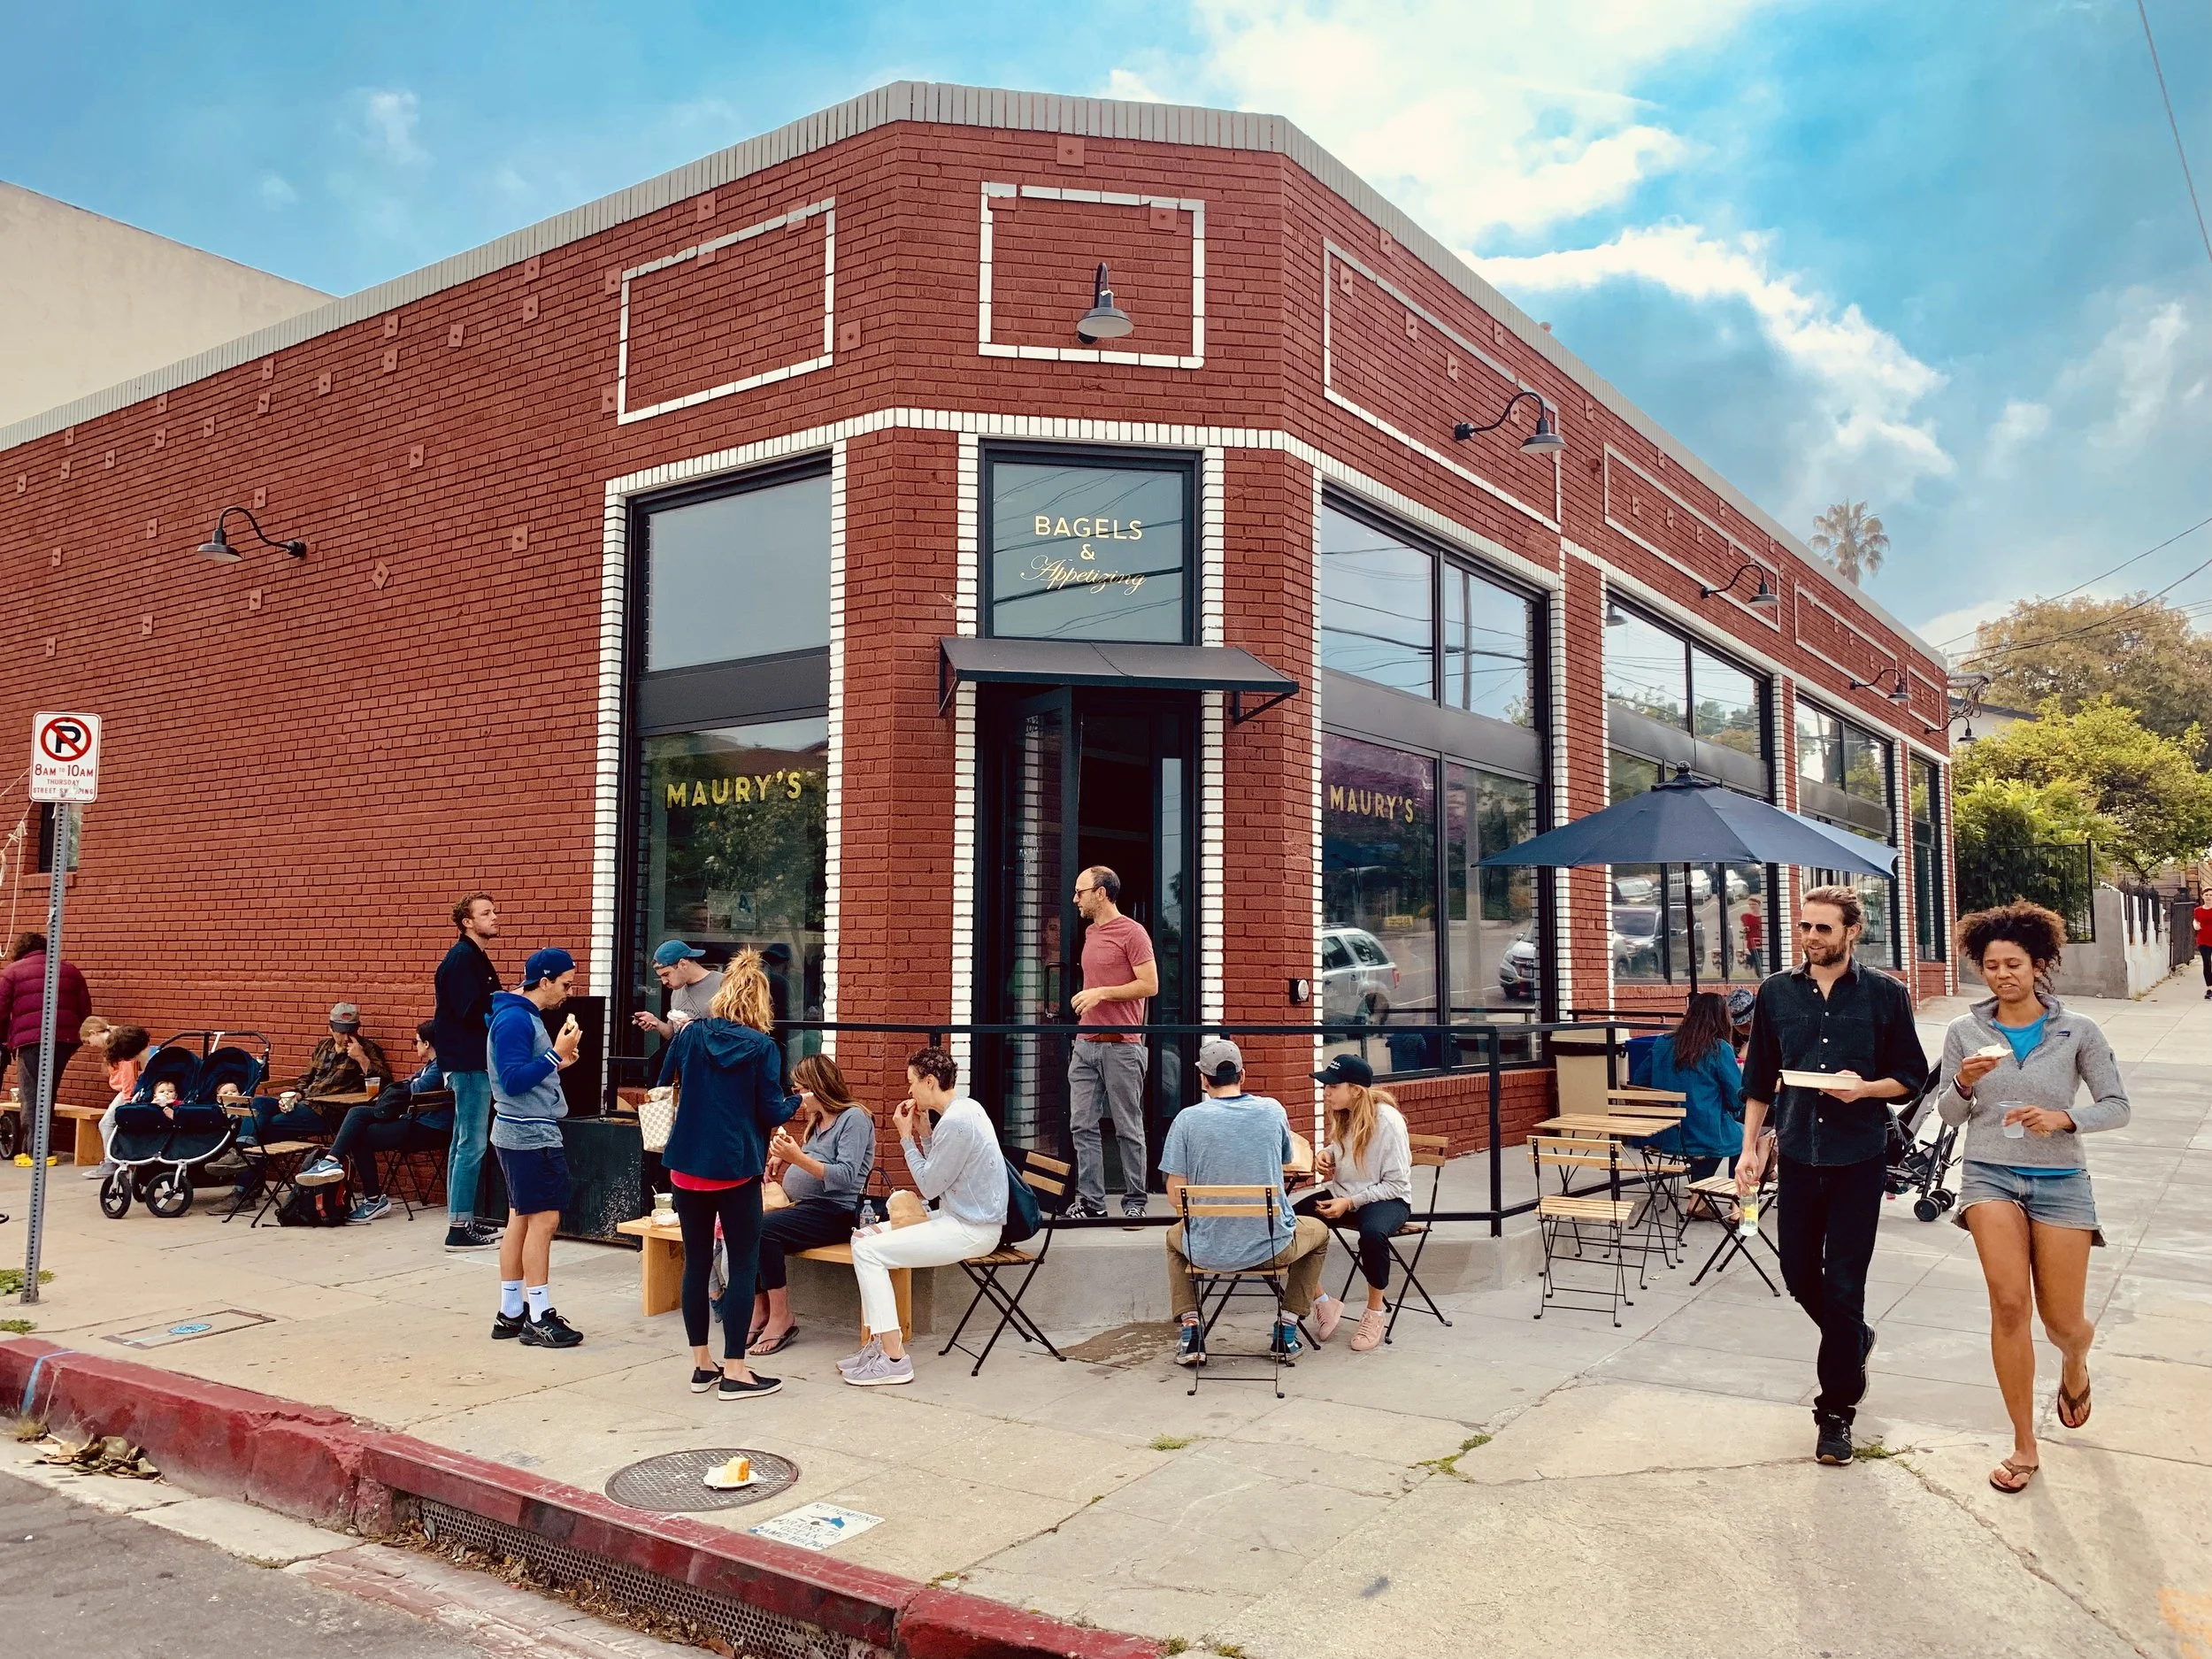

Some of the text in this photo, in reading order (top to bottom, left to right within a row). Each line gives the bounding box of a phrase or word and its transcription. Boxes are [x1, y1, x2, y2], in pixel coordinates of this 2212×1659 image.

[1034, 515, 1143, 541] BAGELS
[1079, 543, 1095, 560] &
[1020, 555, 1148, 595] Appetizing
[35, 764, 57, 776] 8AM
[67, 764, 94, 777] 10AM
[667, 771, 802, 809] MAURY'S
[1330, 784, 1414, 823] MAURY'S
